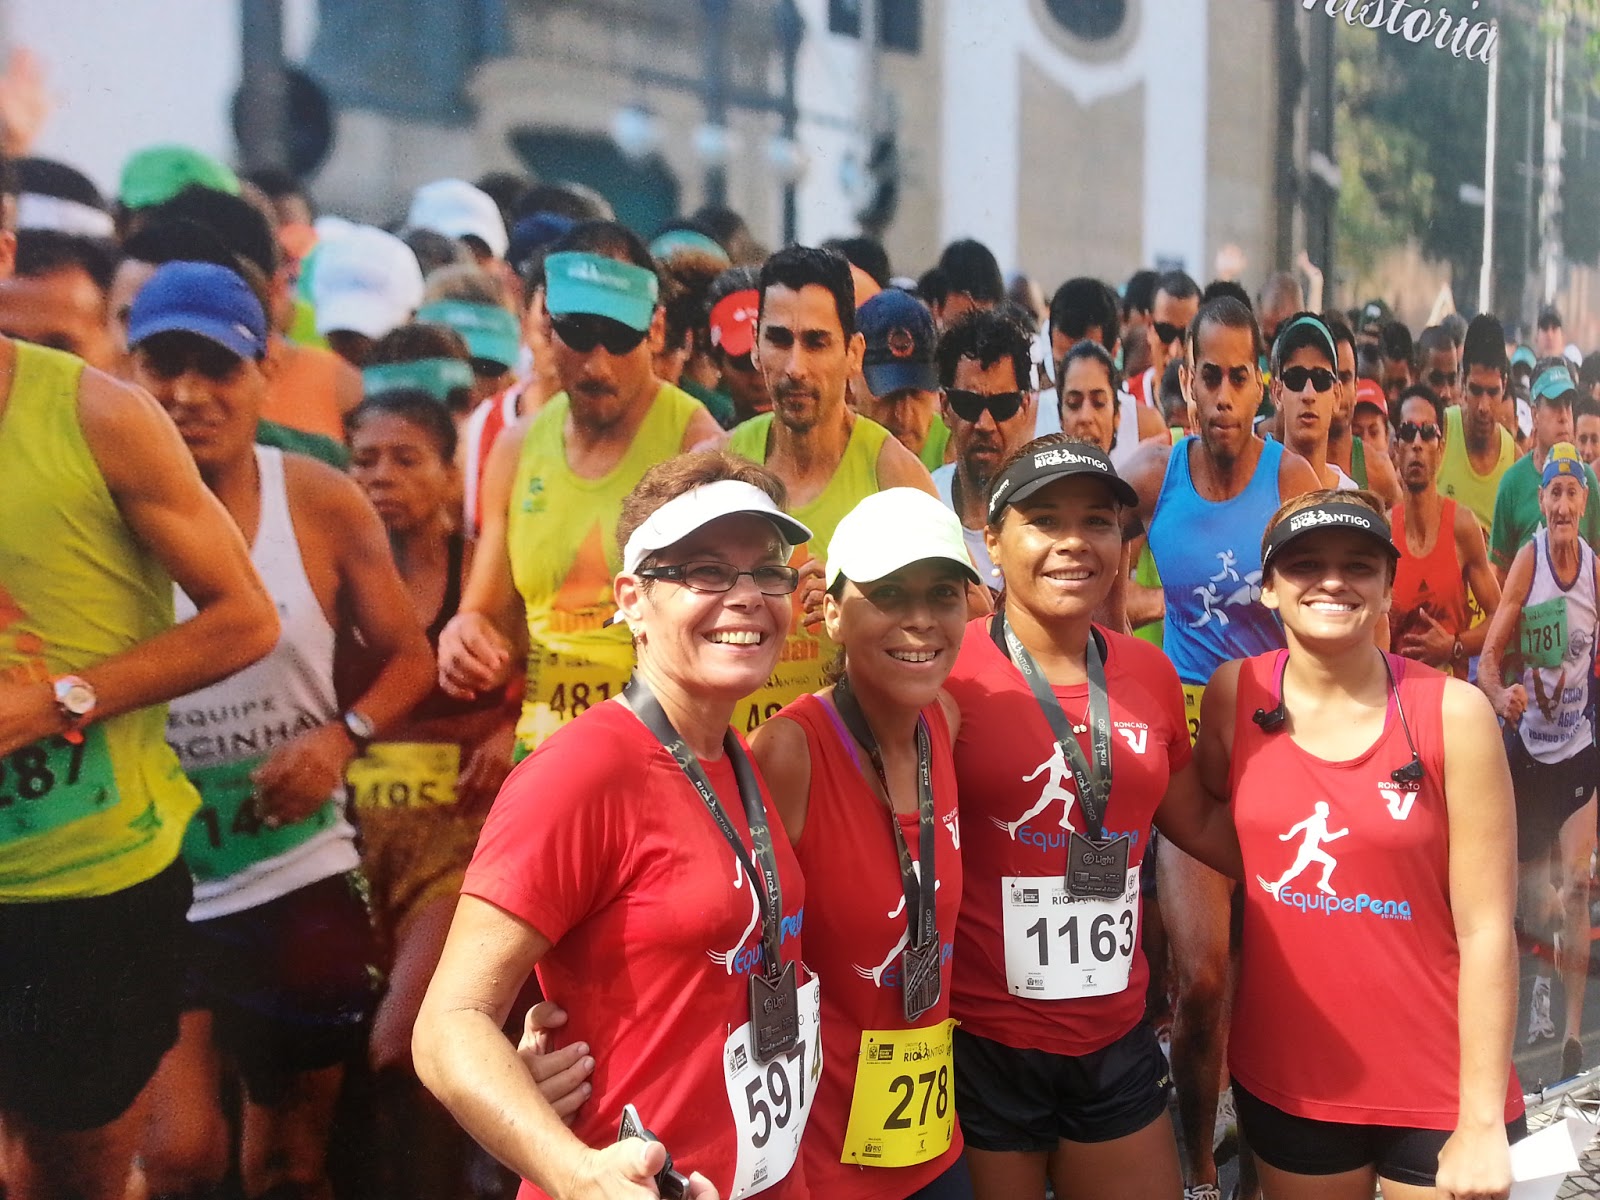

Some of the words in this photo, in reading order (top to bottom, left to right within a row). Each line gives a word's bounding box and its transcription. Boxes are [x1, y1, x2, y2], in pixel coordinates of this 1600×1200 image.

[1070, 453, 1108, 472] ANTIGO
[1327, 513, 1371, 528] ANTIGO
[1526, 621, 1562, 654] 1781
[1377, 781, 1420, 790] RONCATO
[1095, 854, 1115, 866] Light
[1052, 895, 1070, 905] RIO
[1026, 909, 1134, 967] 1163
[883, 1065, 948, 1130] 278
